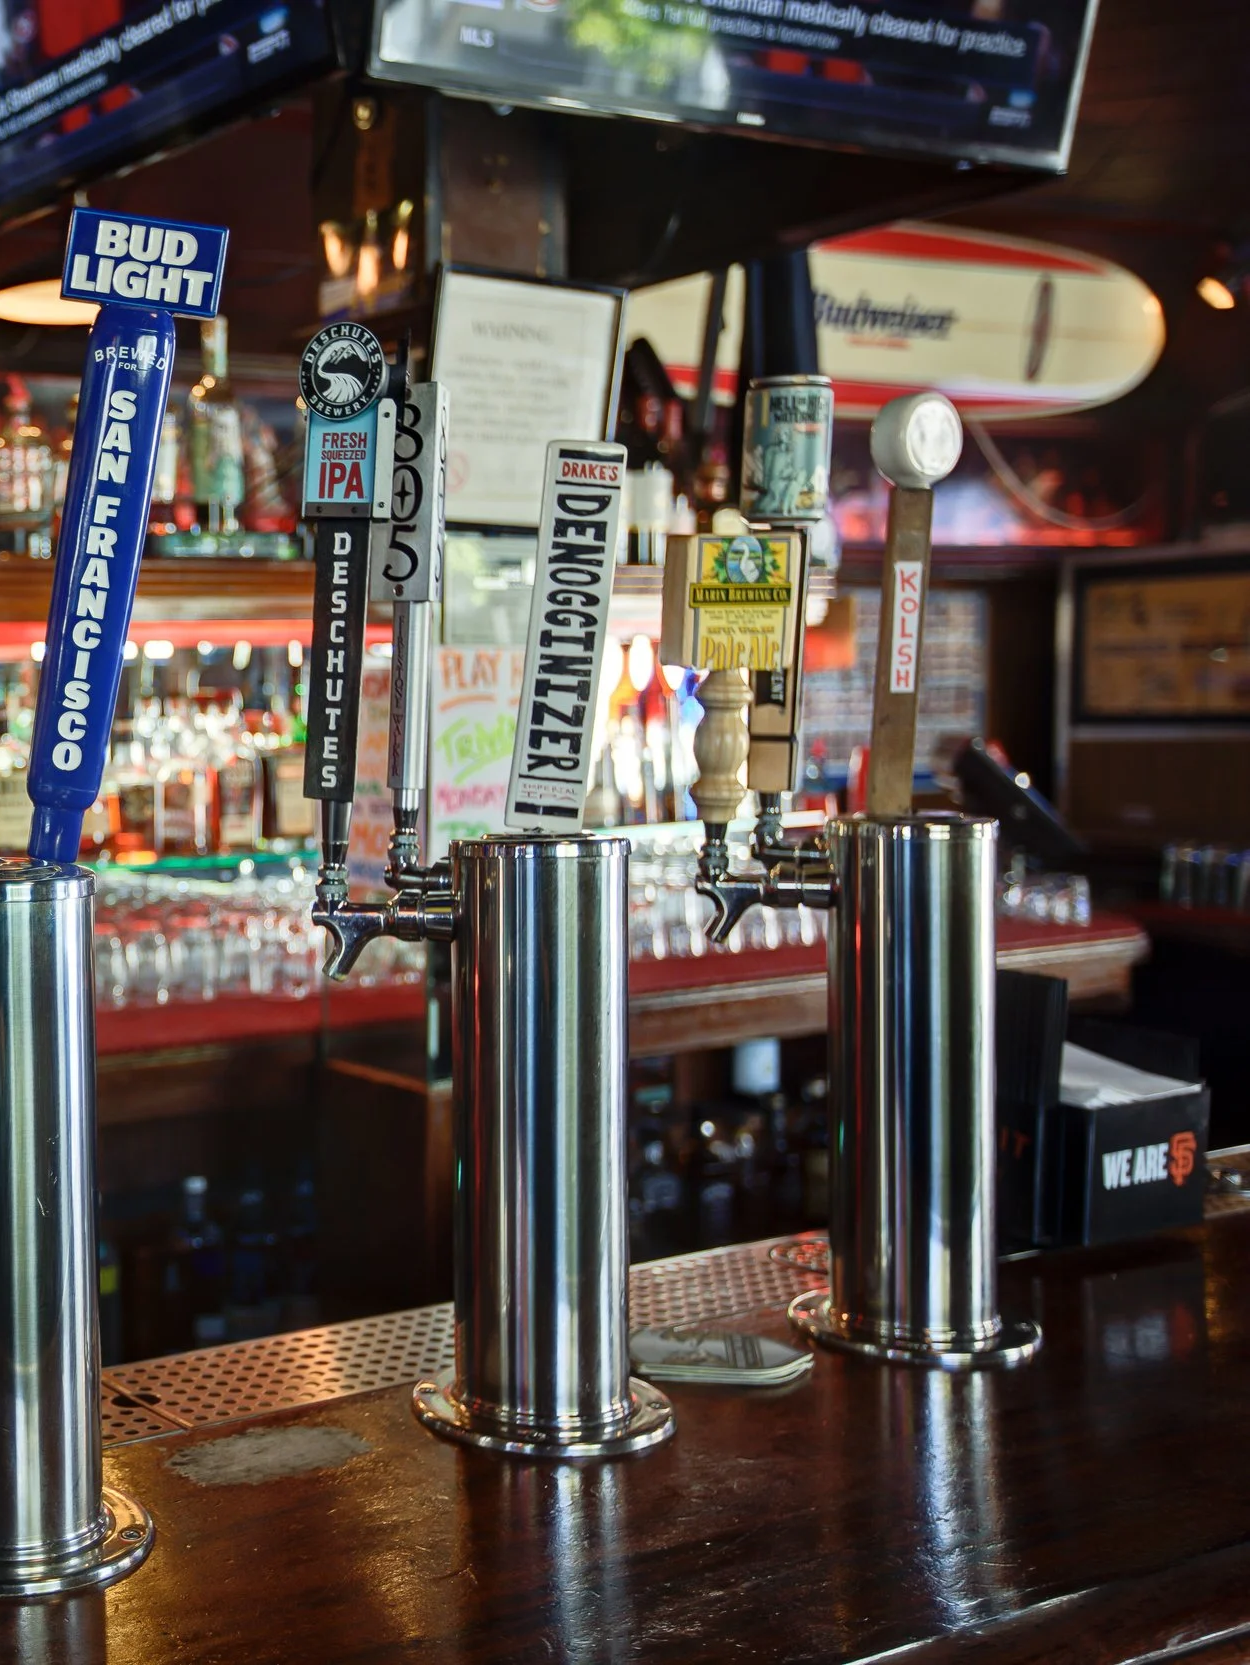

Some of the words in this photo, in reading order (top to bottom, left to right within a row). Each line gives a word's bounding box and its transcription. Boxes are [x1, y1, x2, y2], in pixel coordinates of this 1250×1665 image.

[95, 220, 198, 266] BUD
[71, 254, 213, 306] LIGHT
[95, 346, 165, 370] BREWED
[305, 324, 381, 364] DESCHUTES
[310, 394, 368, 416] BREWERY
[98, 389, 137, 485] SAN
[321, 450, 366, 461] SQUEEZED
[322, 432, 367, 449] FRESH
[318, 462, 364, 499] IPA
[562, 461, 618, 480] DRAKE'S
[382, 403, 424, 583] 805
[693, 587, 727, 602] MARIN
[729, 587, 771, 602] BREWING
[52, 495, 121, 772] FRANCISCO
[526, 492, 612, 773] DENOGGINIZER
[896, 568, 919, 689] KOLSH
[321, 531, 352, 789] DESCHUTES
[701, 635, 745, 670] Pale
[748, 635, 779, 670] Ale
[1102, 1149, 1132, 1190] WE
[1133, 1142, 1169, 1185] ARE
